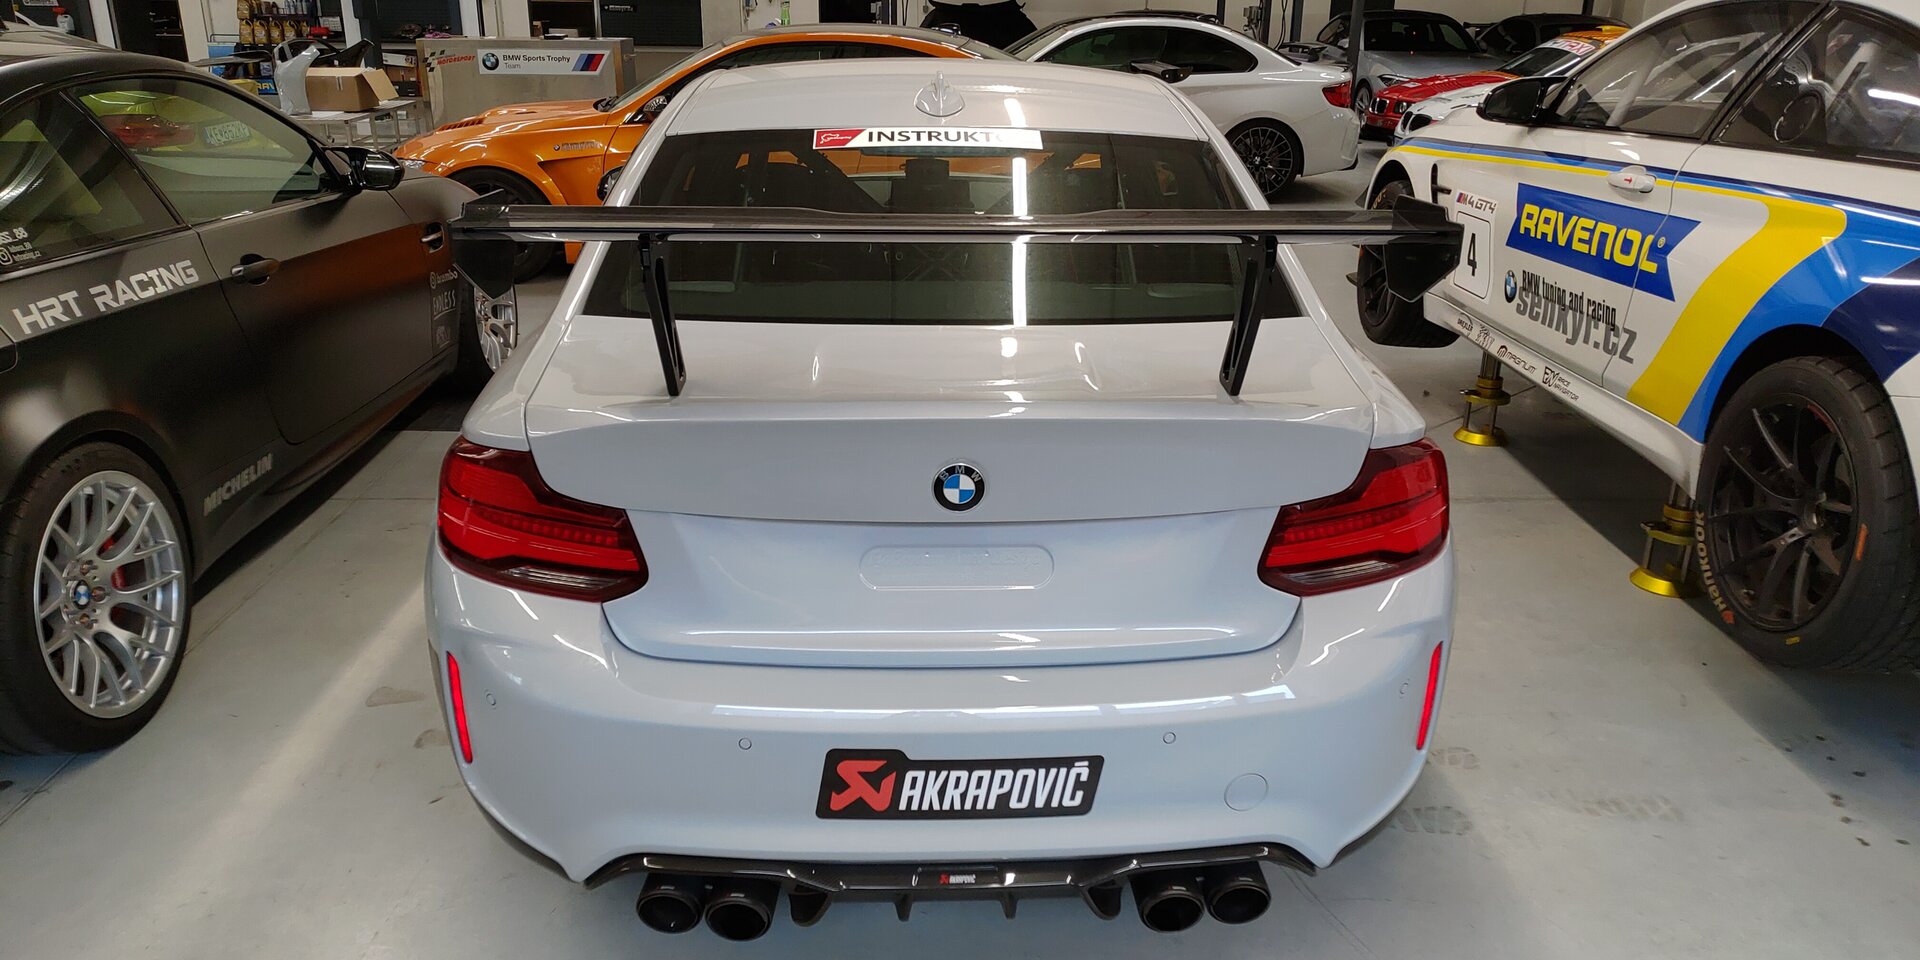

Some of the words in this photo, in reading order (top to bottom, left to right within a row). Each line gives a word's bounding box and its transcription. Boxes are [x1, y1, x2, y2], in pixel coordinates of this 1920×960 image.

[437, 55, 475, 65] MOTORSPORT
[502, 54, 521, 62] BMW
[522, 54, 546, 63] Sports
[547, 55, 570, 63] Trophy
[868, 130, 999, 143] INSTRUKT
[1467, 232, 1477, 277] 4
[1519, 203, 1658, 274] RAVENOL
[12, 290, 83, 335] HRT
[88, 260, 200, 312] RACING
[1522, 269, 1541, 298] BMW
[1542, 276, 1566, 312] tuning
[1569, 291, 1585, 315] and
[1586, 299, 1616, 332] racing
[1505, 351, 1537, 374] MAGNUM
[203, 452, 273, 517] MICHELIN
[898, 760, 1090, 811] AKRAPOVIČ
